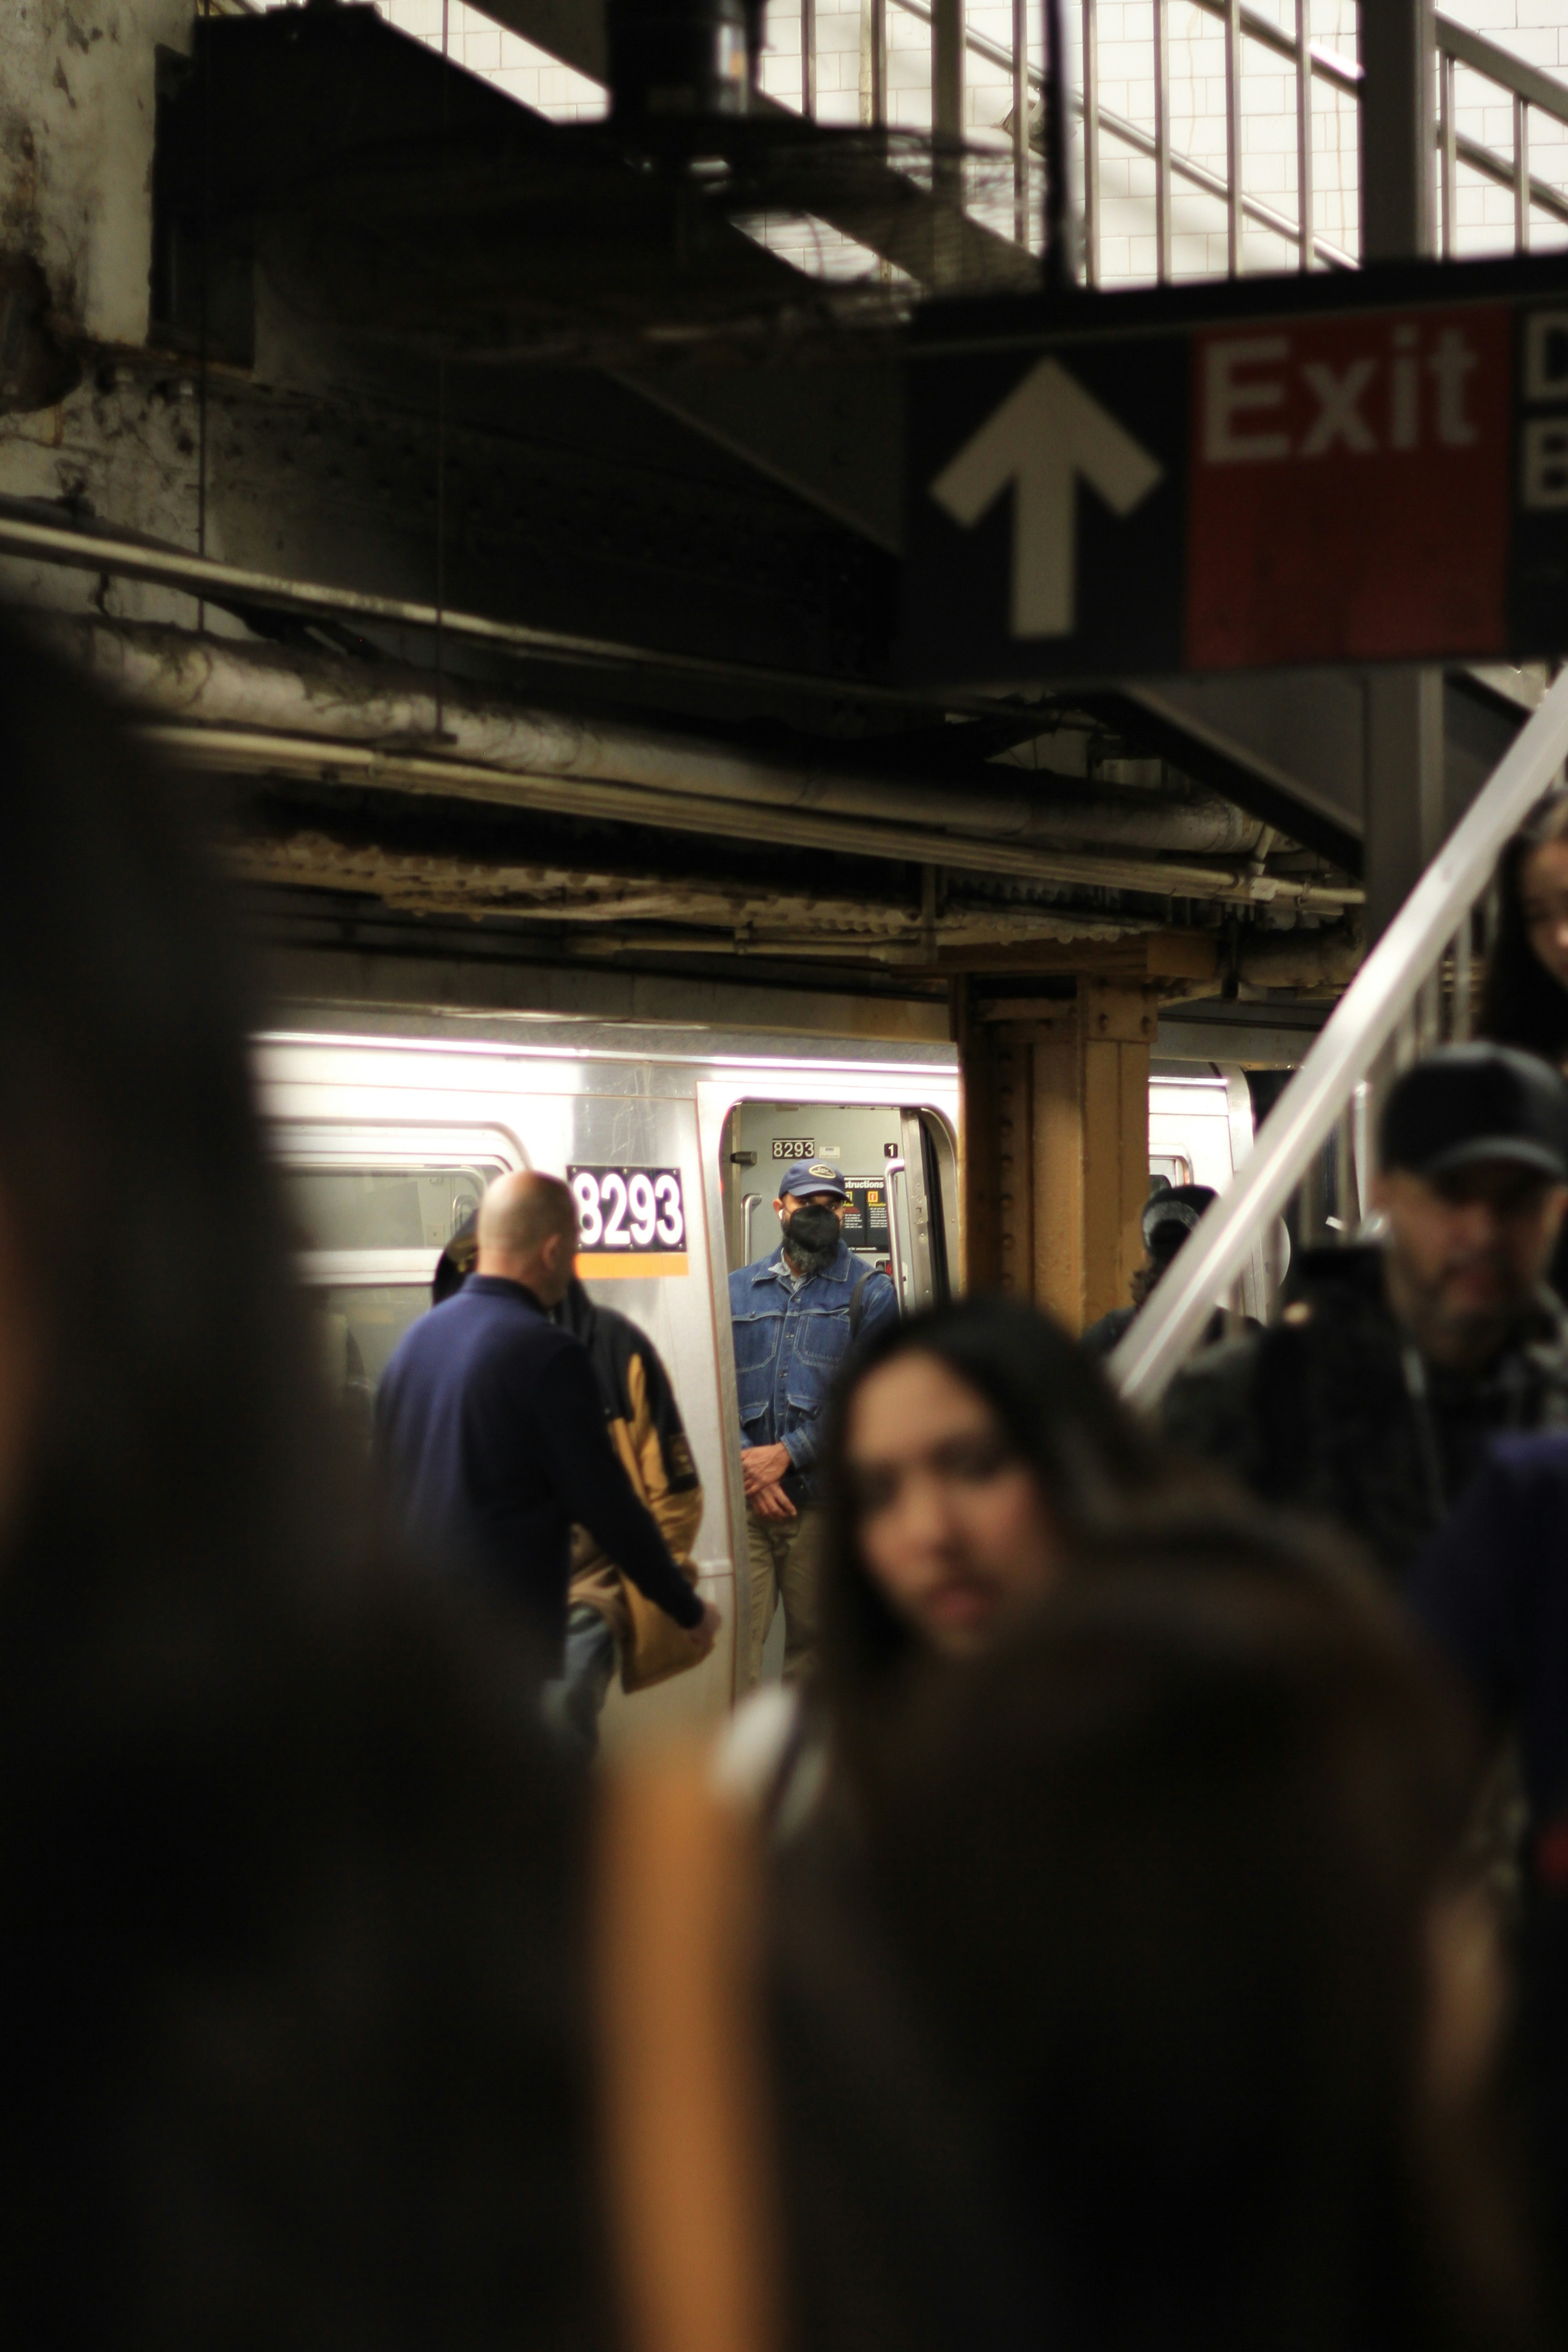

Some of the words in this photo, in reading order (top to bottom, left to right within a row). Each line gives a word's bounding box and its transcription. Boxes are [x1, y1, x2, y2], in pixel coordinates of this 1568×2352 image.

[1201, 323, 1479, 466] Exit
[773, 1142, 814, 1157] 8293
[888, 1145, 894, 1156] 1
[573, 1172, 683, 1245] 8293
